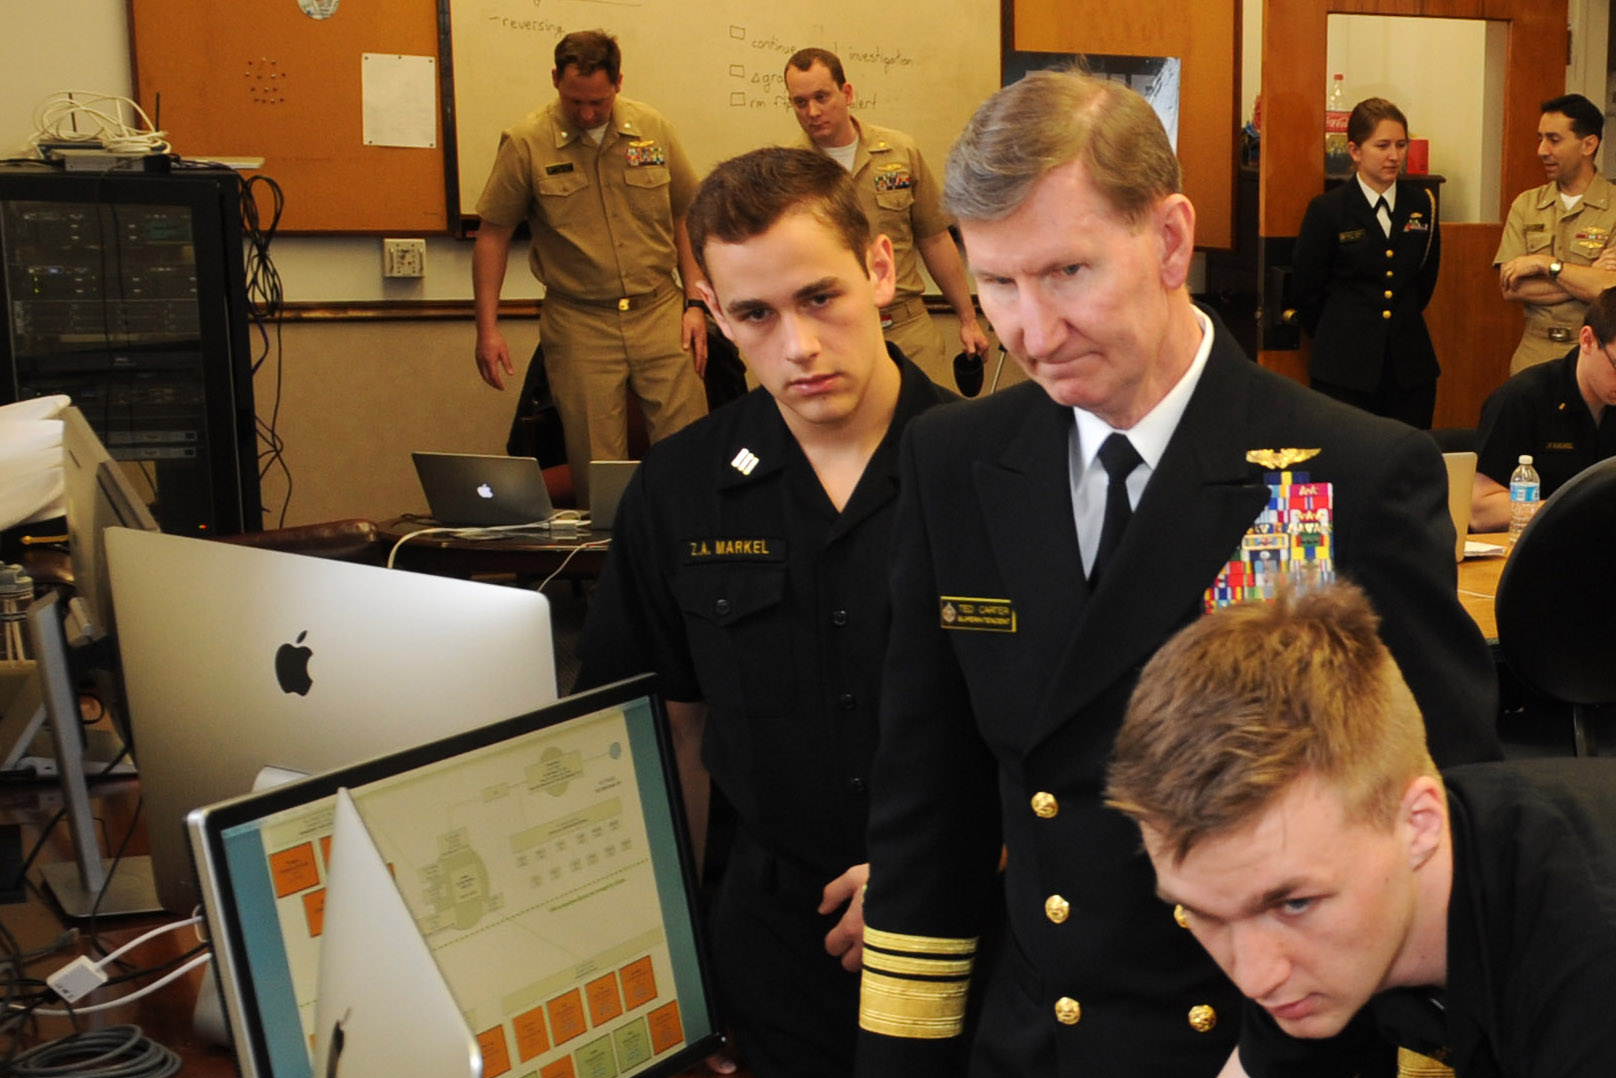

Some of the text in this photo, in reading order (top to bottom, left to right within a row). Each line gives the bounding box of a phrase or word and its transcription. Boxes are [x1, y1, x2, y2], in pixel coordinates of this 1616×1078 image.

[751, 35, 912, 74] continue investigation
[715, 540, 769, 554] MARKEL
[958, 604, 974, 614] TED
